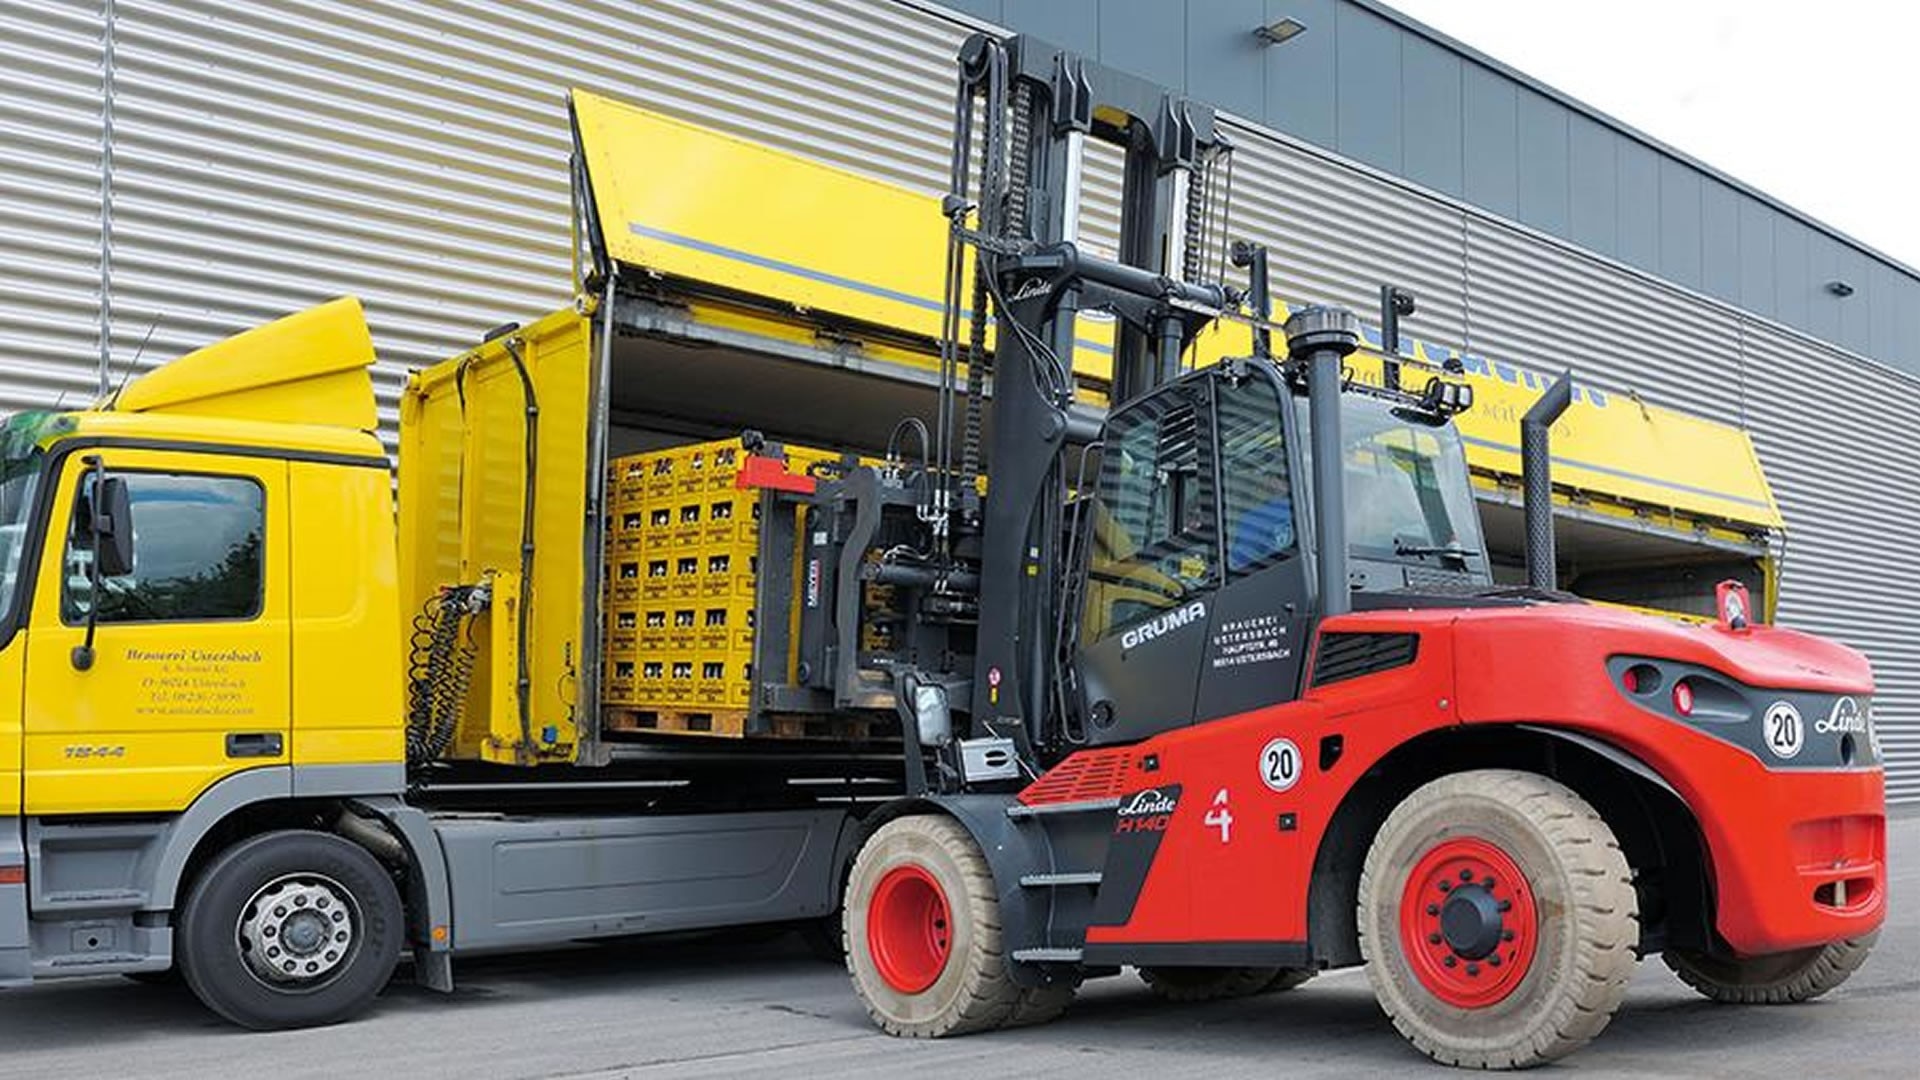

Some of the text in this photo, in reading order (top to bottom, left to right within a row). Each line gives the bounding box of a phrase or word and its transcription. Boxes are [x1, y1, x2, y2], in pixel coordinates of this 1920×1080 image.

[1008, 277, 1052, 302] Linde
[1121, 601, 1206, 649] GRUMA
[1213, 626, 1286, 645] USTERSBACH
[1222, 616, 1277, 632] BRAUEREI
[191, 650, 262, 663] Ustersbach
[1773, 713, 1797, 747] 20
[1268, 749, 1294, 781] 20
[1117, 789, 1176, 816] Linde
[1204, 788, 1233, 843] 4
